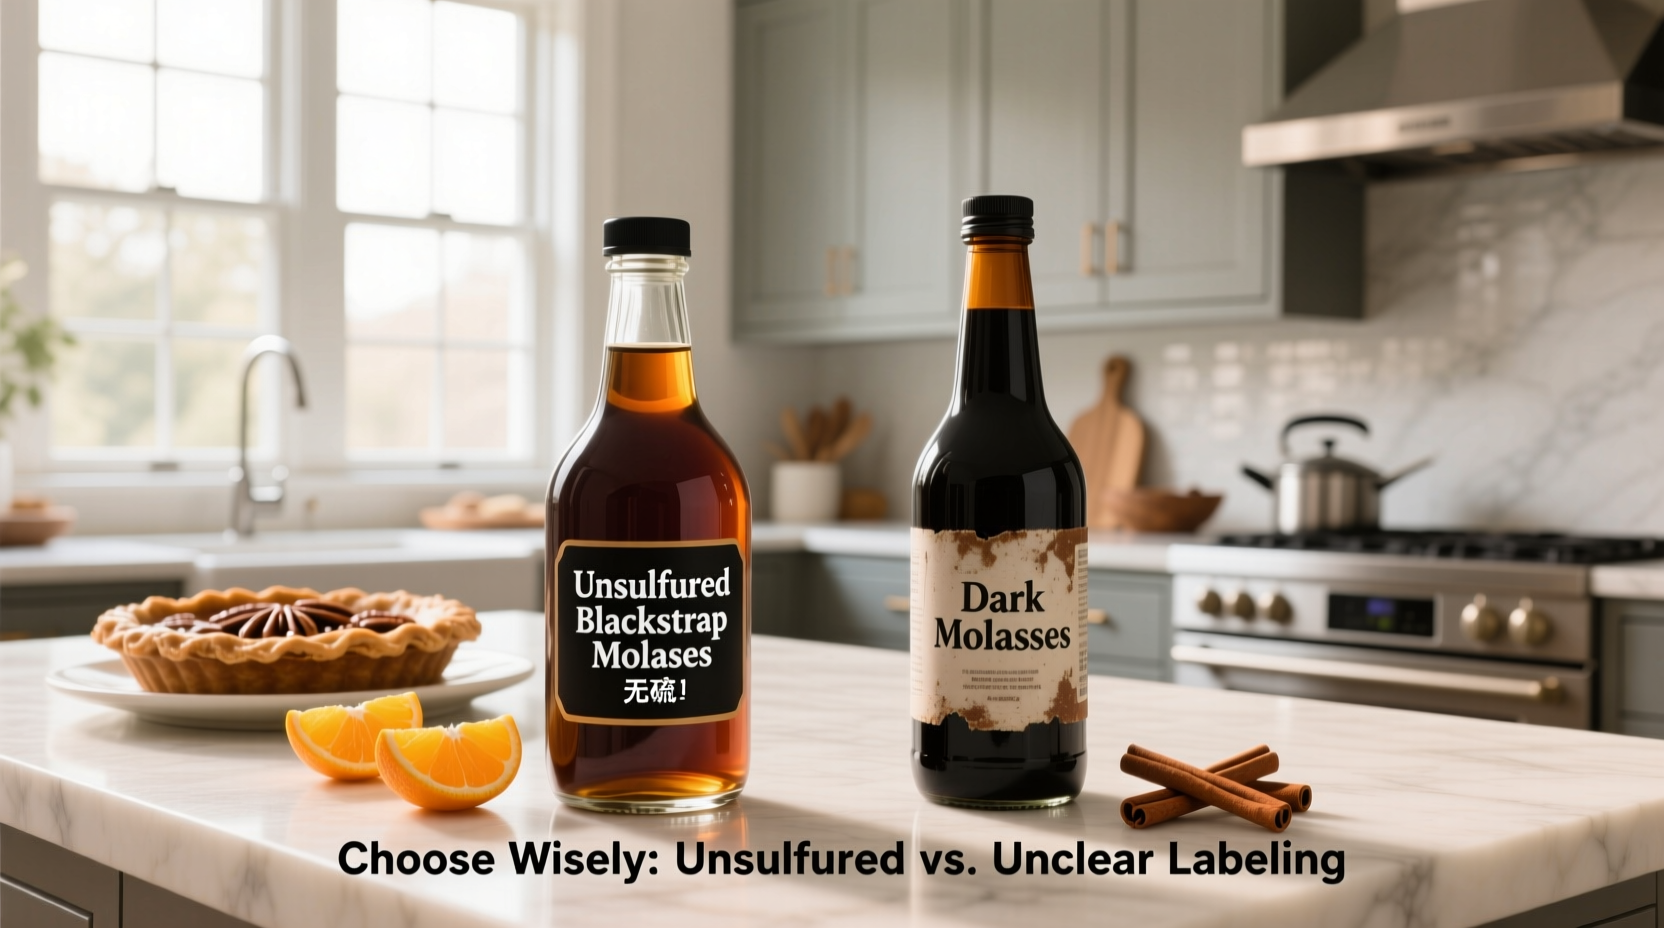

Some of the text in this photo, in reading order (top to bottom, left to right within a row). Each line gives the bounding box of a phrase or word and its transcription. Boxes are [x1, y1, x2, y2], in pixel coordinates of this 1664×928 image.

[574, 567, 730, 600] Unsulfured
[961, 580, 1045, 613] Dark
[576, 605, 727, 641] Blackstrap
[934, 617, 1070, 650] Molasses
[592, 639, 712, 669] Molases
